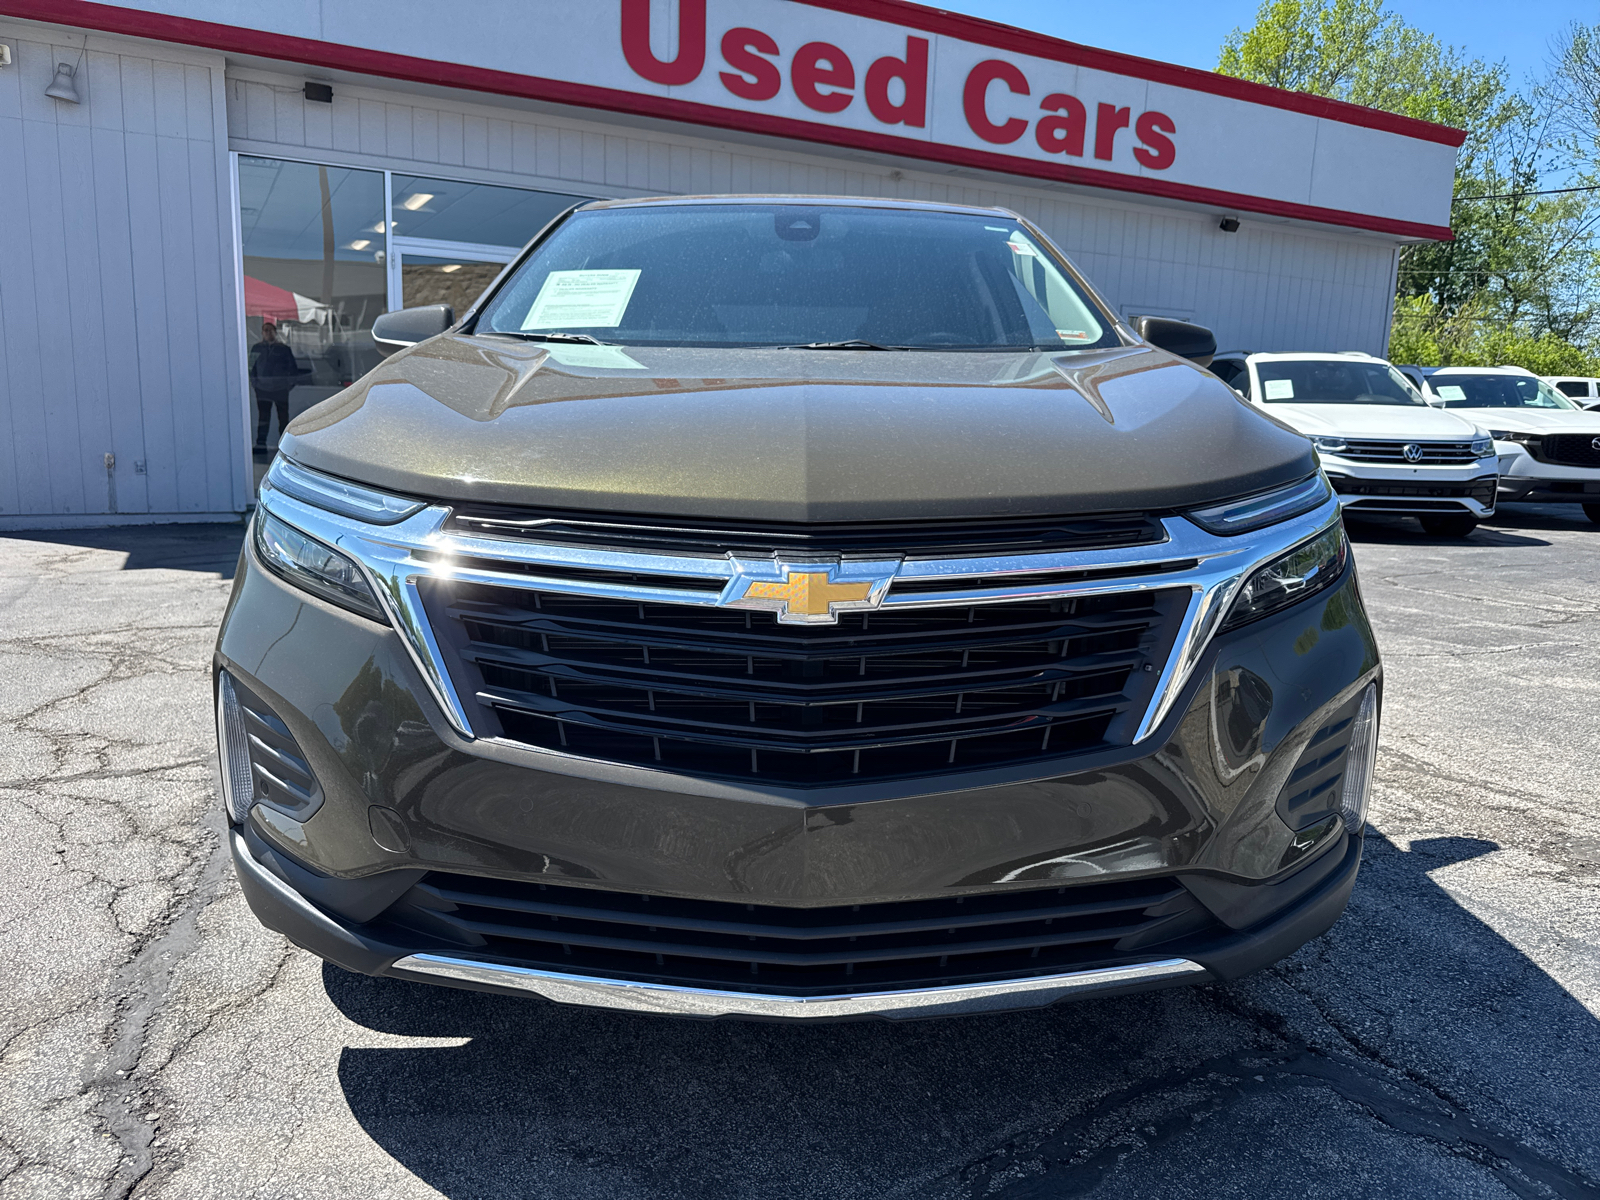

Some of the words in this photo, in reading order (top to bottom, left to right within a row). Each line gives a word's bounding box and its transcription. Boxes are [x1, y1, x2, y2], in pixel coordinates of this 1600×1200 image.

[621, 0, 929, 128] Used
[963, 59, 1176, 170] Cars
[1403, 444, 1423, 462] VW
